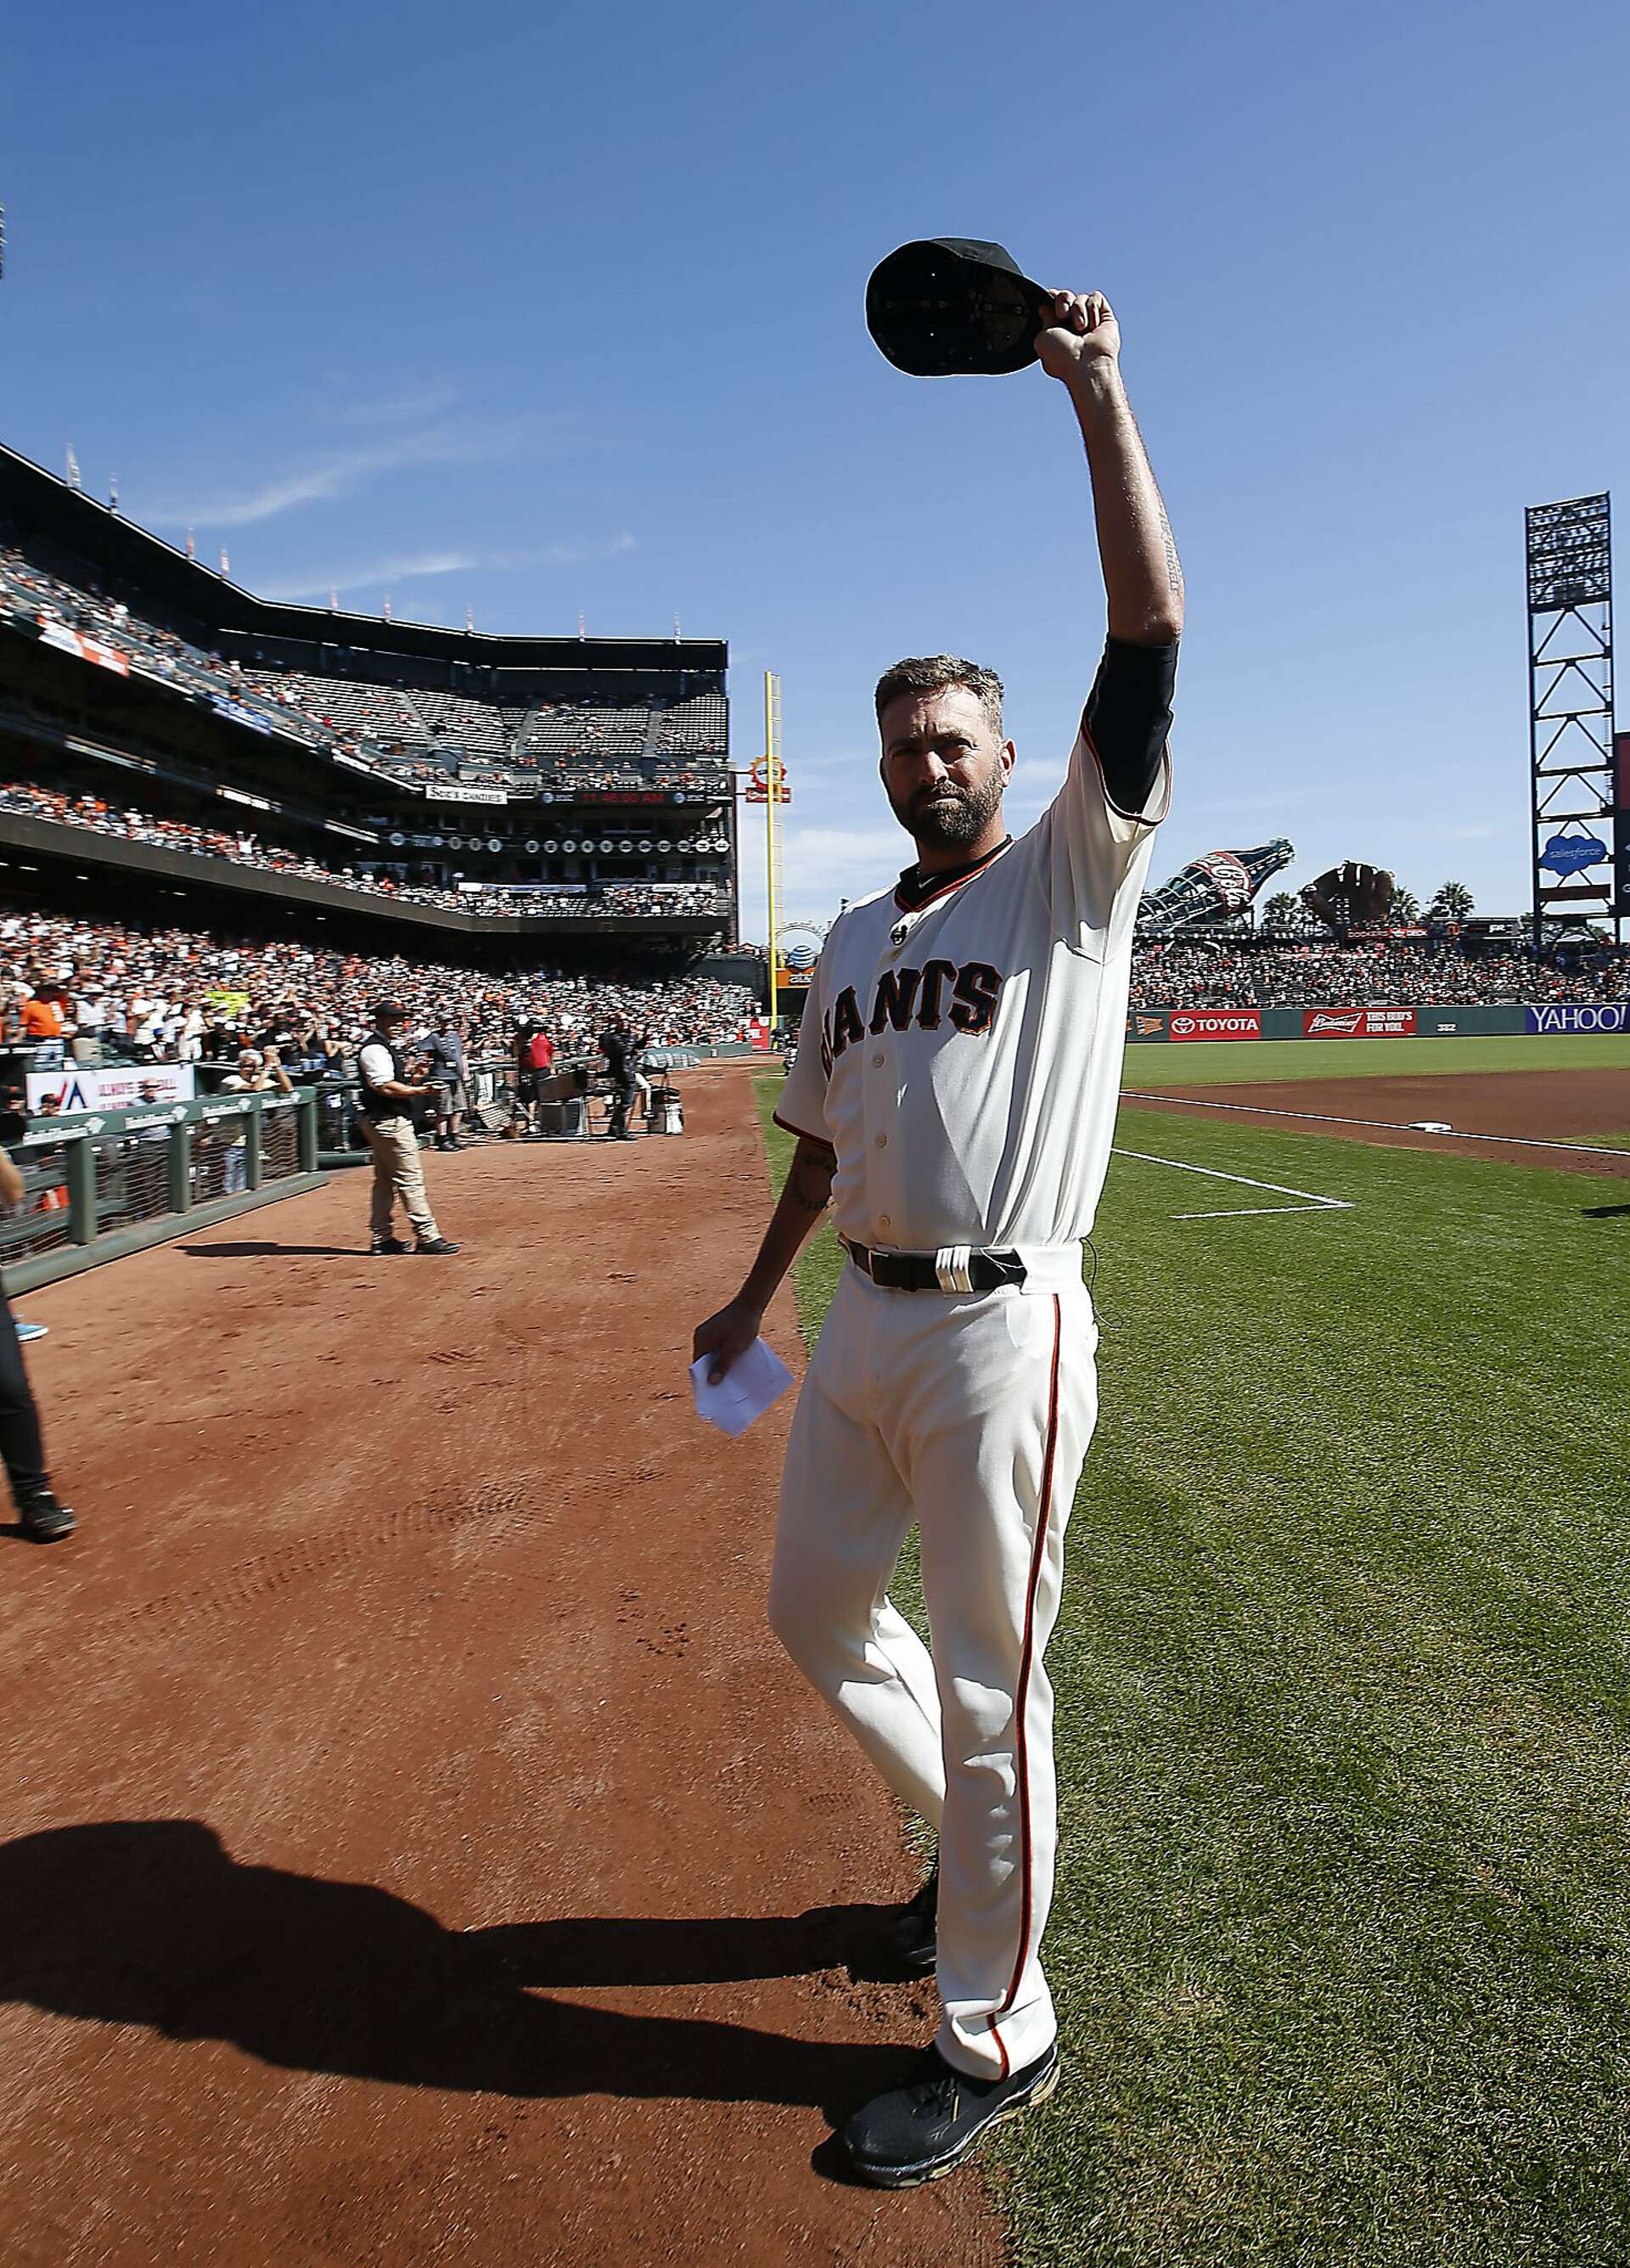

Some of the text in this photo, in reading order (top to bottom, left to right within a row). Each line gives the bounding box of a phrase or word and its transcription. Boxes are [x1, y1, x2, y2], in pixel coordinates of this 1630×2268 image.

[1549, 848, 1602, 859] salesforce
[1196, 1018, 1259, 1032] TOYOTA
[1531, 1005, 1627, 1033] YAHOO!
